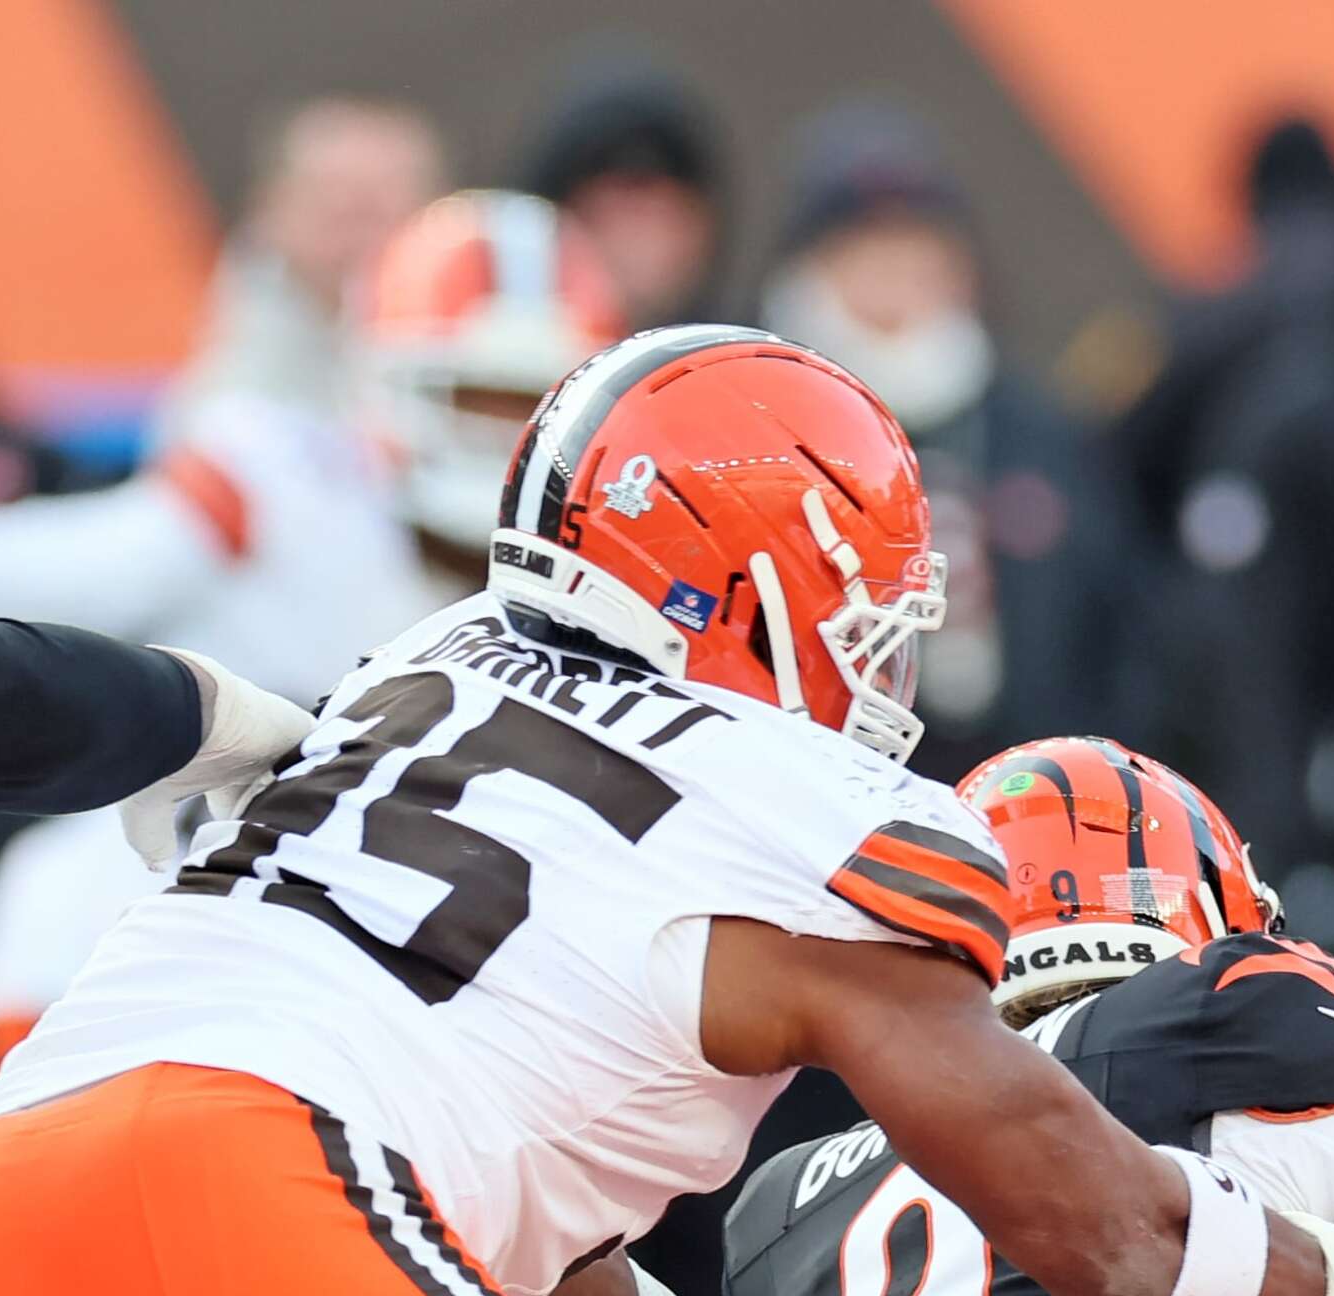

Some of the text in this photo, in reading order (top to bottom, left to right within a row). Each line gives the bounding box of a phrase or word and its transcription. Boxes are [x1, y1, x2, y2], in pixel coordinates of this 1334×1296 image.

[164, 670, 683, 1007] 95
[1050, 870, 1080, 921] 9
[1002, 941, 1156, 982] NGALS
